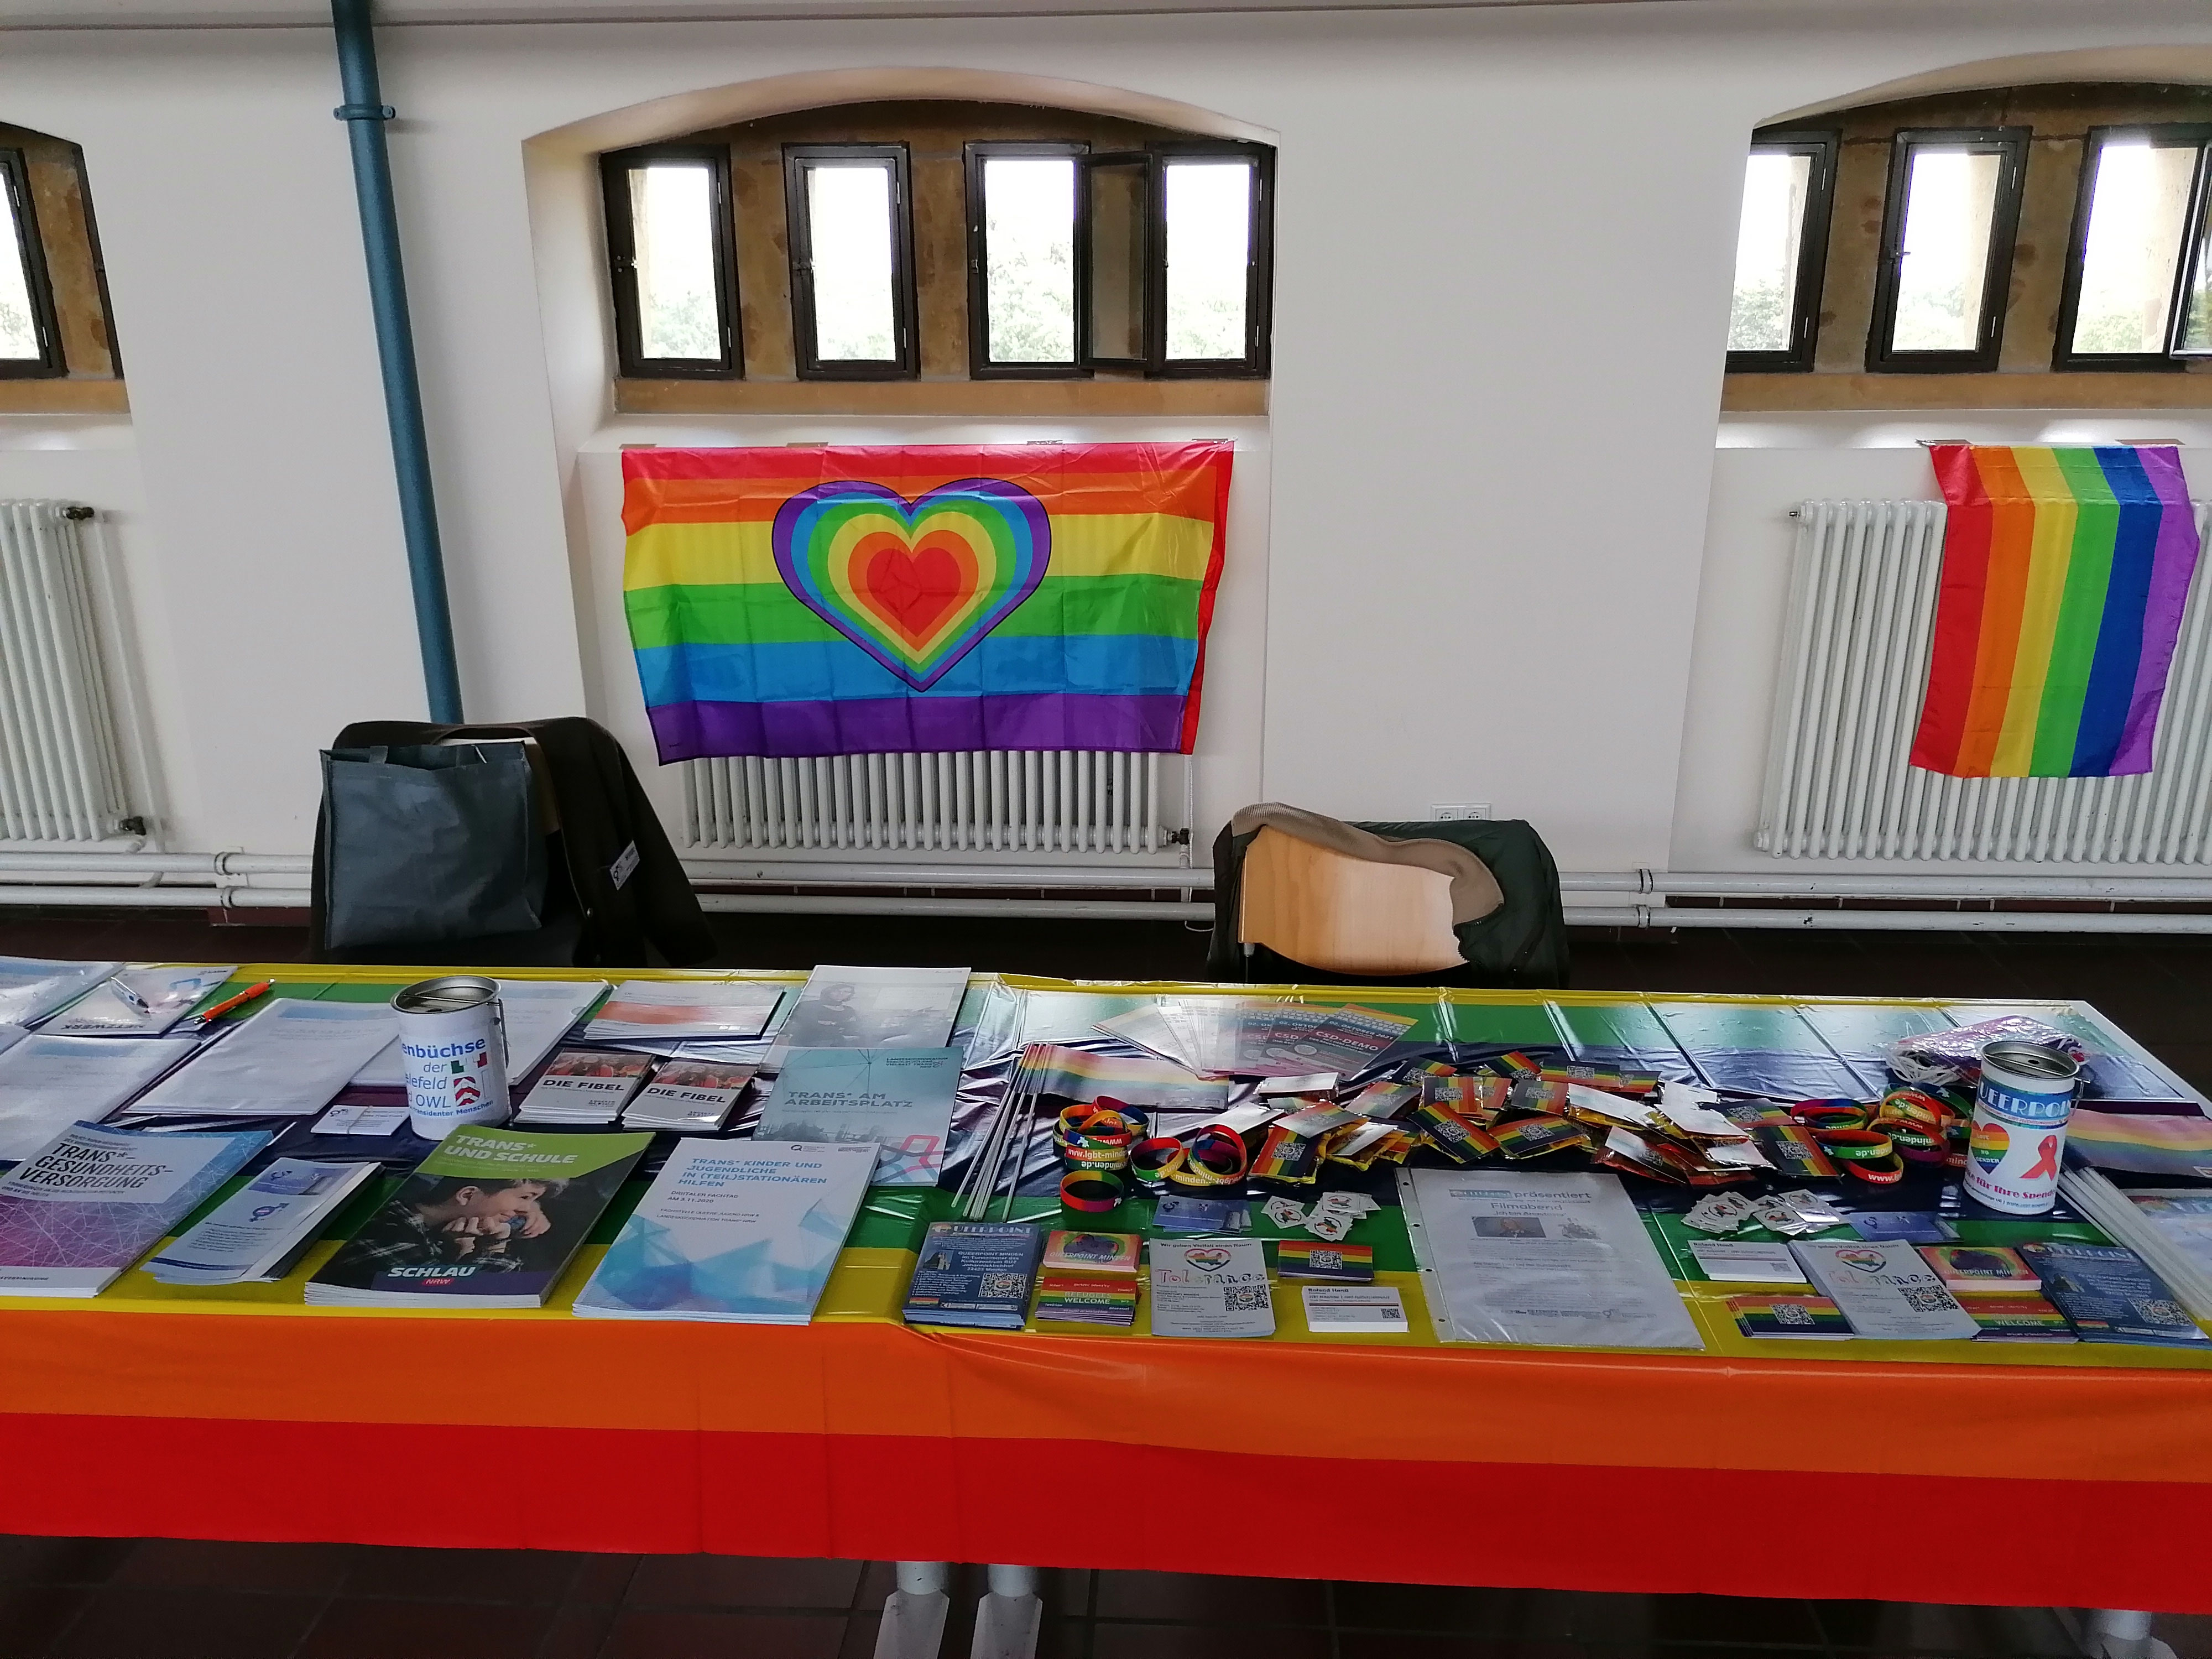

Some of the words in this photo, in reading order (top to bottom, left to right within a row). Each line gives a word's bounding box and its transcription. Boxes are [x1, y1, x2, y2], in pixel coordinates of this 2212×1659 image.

[1316, 1031, 1379, 1051] CSD-DEMO
[424, 1062, 447, 1073] der
[542, 1079, 573, 1088] DIE
[577, 1082, 624, 1092] FIBEL
[416, 1094, 451, 1108] OWL
[647, 1087, 677, 1097] DIE
[680, 1092, 726, 1103] FIBEL
[456, 1099, 493, 1115] Menschen
[784, 1099, 913, 1108] ARBEITSPLATZ
[444, 1145, 492, 1160] UND
[493, 1152, 578, 1164] SCHULE
[686, 1165, 777, 1174] JUGENDLICHE
[19, 1167, 148, 1188] VERSORGUNG
[677, 1179, 725, 1187] HILFEN
[1976, 1177, 1992, 1190] für
[1994, 1185, 2020, 1198] Ihre
[1490, 1202, 1563, 1211] Filmabend
[387, 1266, 476, 1277] SCHLAU
